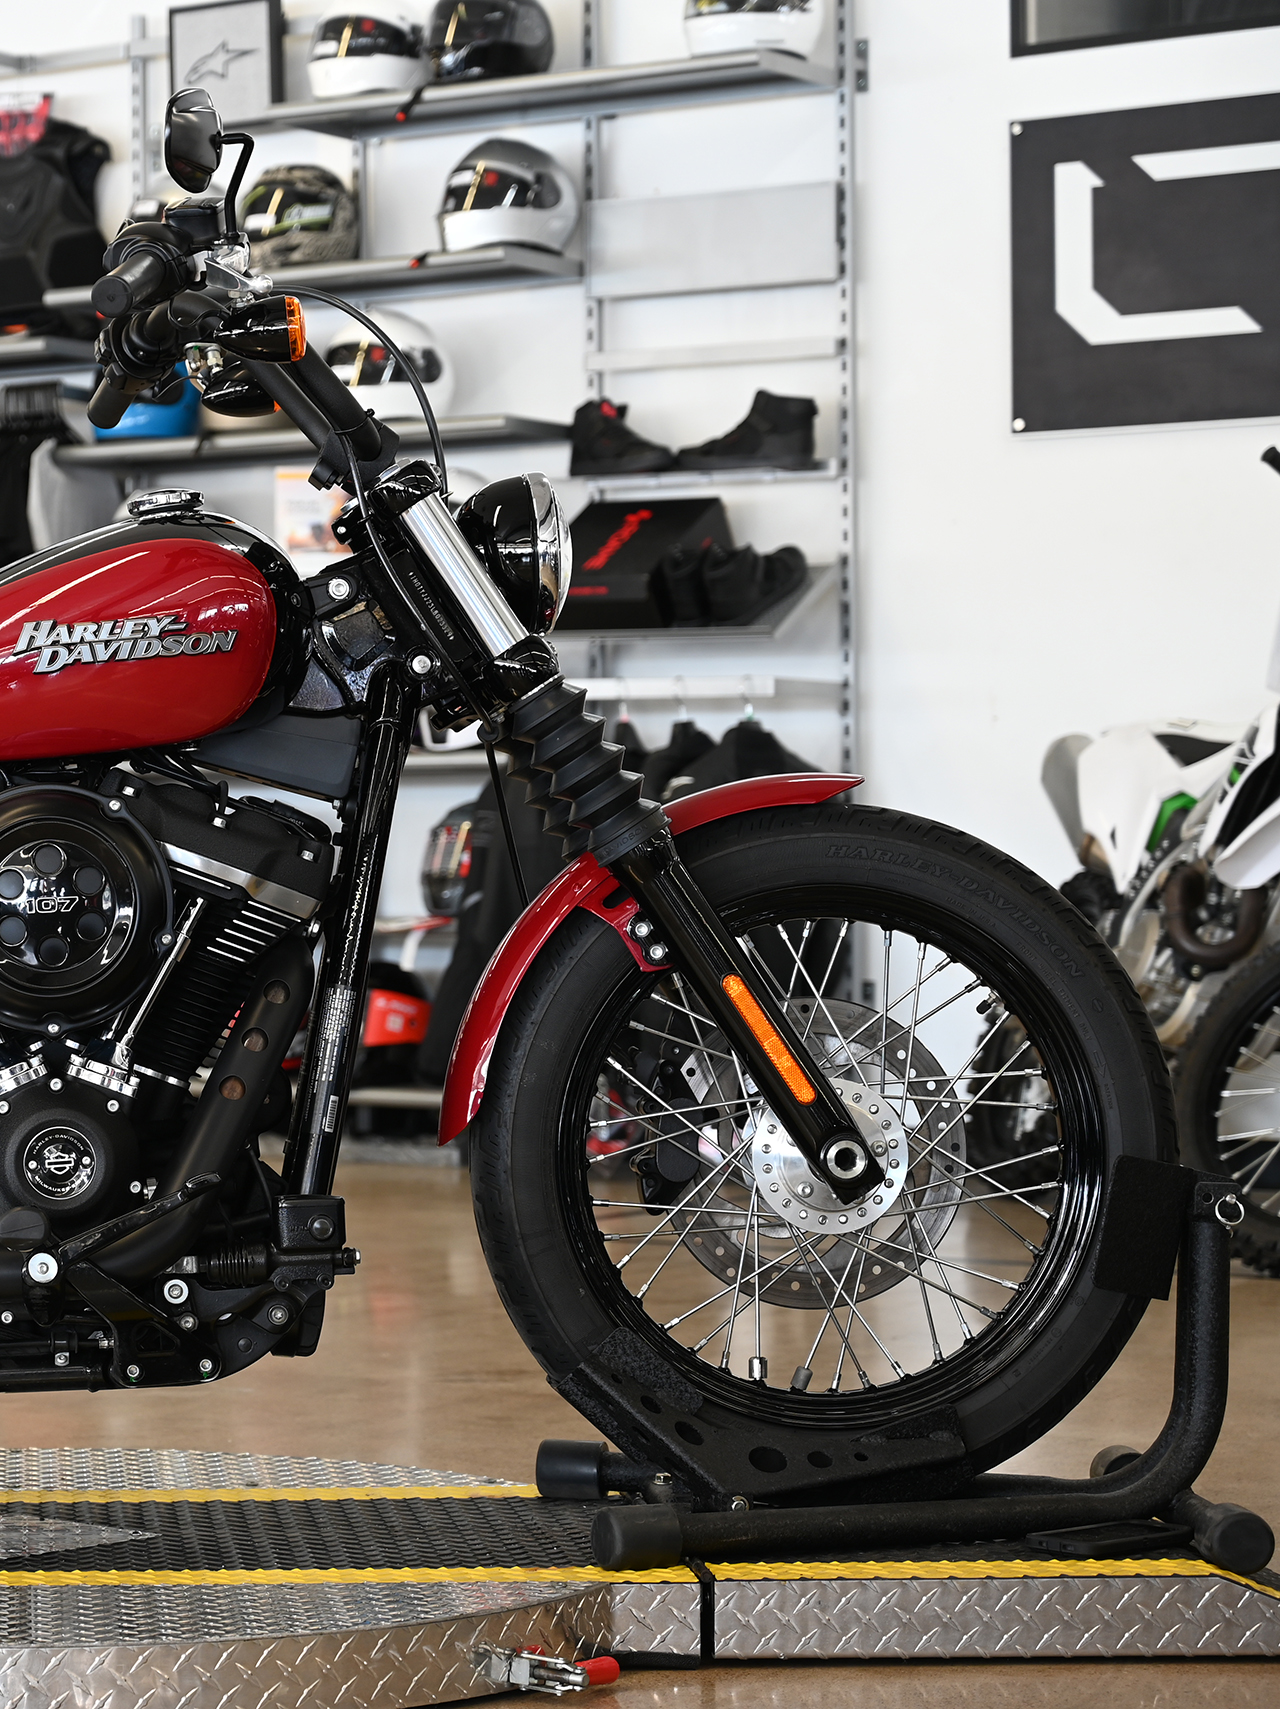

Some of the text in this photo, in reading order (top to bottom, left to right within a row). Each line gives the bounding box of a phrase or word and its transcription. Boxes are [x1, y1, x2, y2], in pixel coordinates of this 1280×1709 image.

[12, 615, 189, 657] HARLEY-
[32, 630, 239, 675] DAVIDSON
[25, 895, 79, 914] 107
[825, 843, 1085, 979] HARLEY-DAVIDSON
[1015, 938, 1037, 963] FRONT
[1037, 961, 1058, 986] WHEEL
[1056, 987, 1082, 1018] FITMENT
